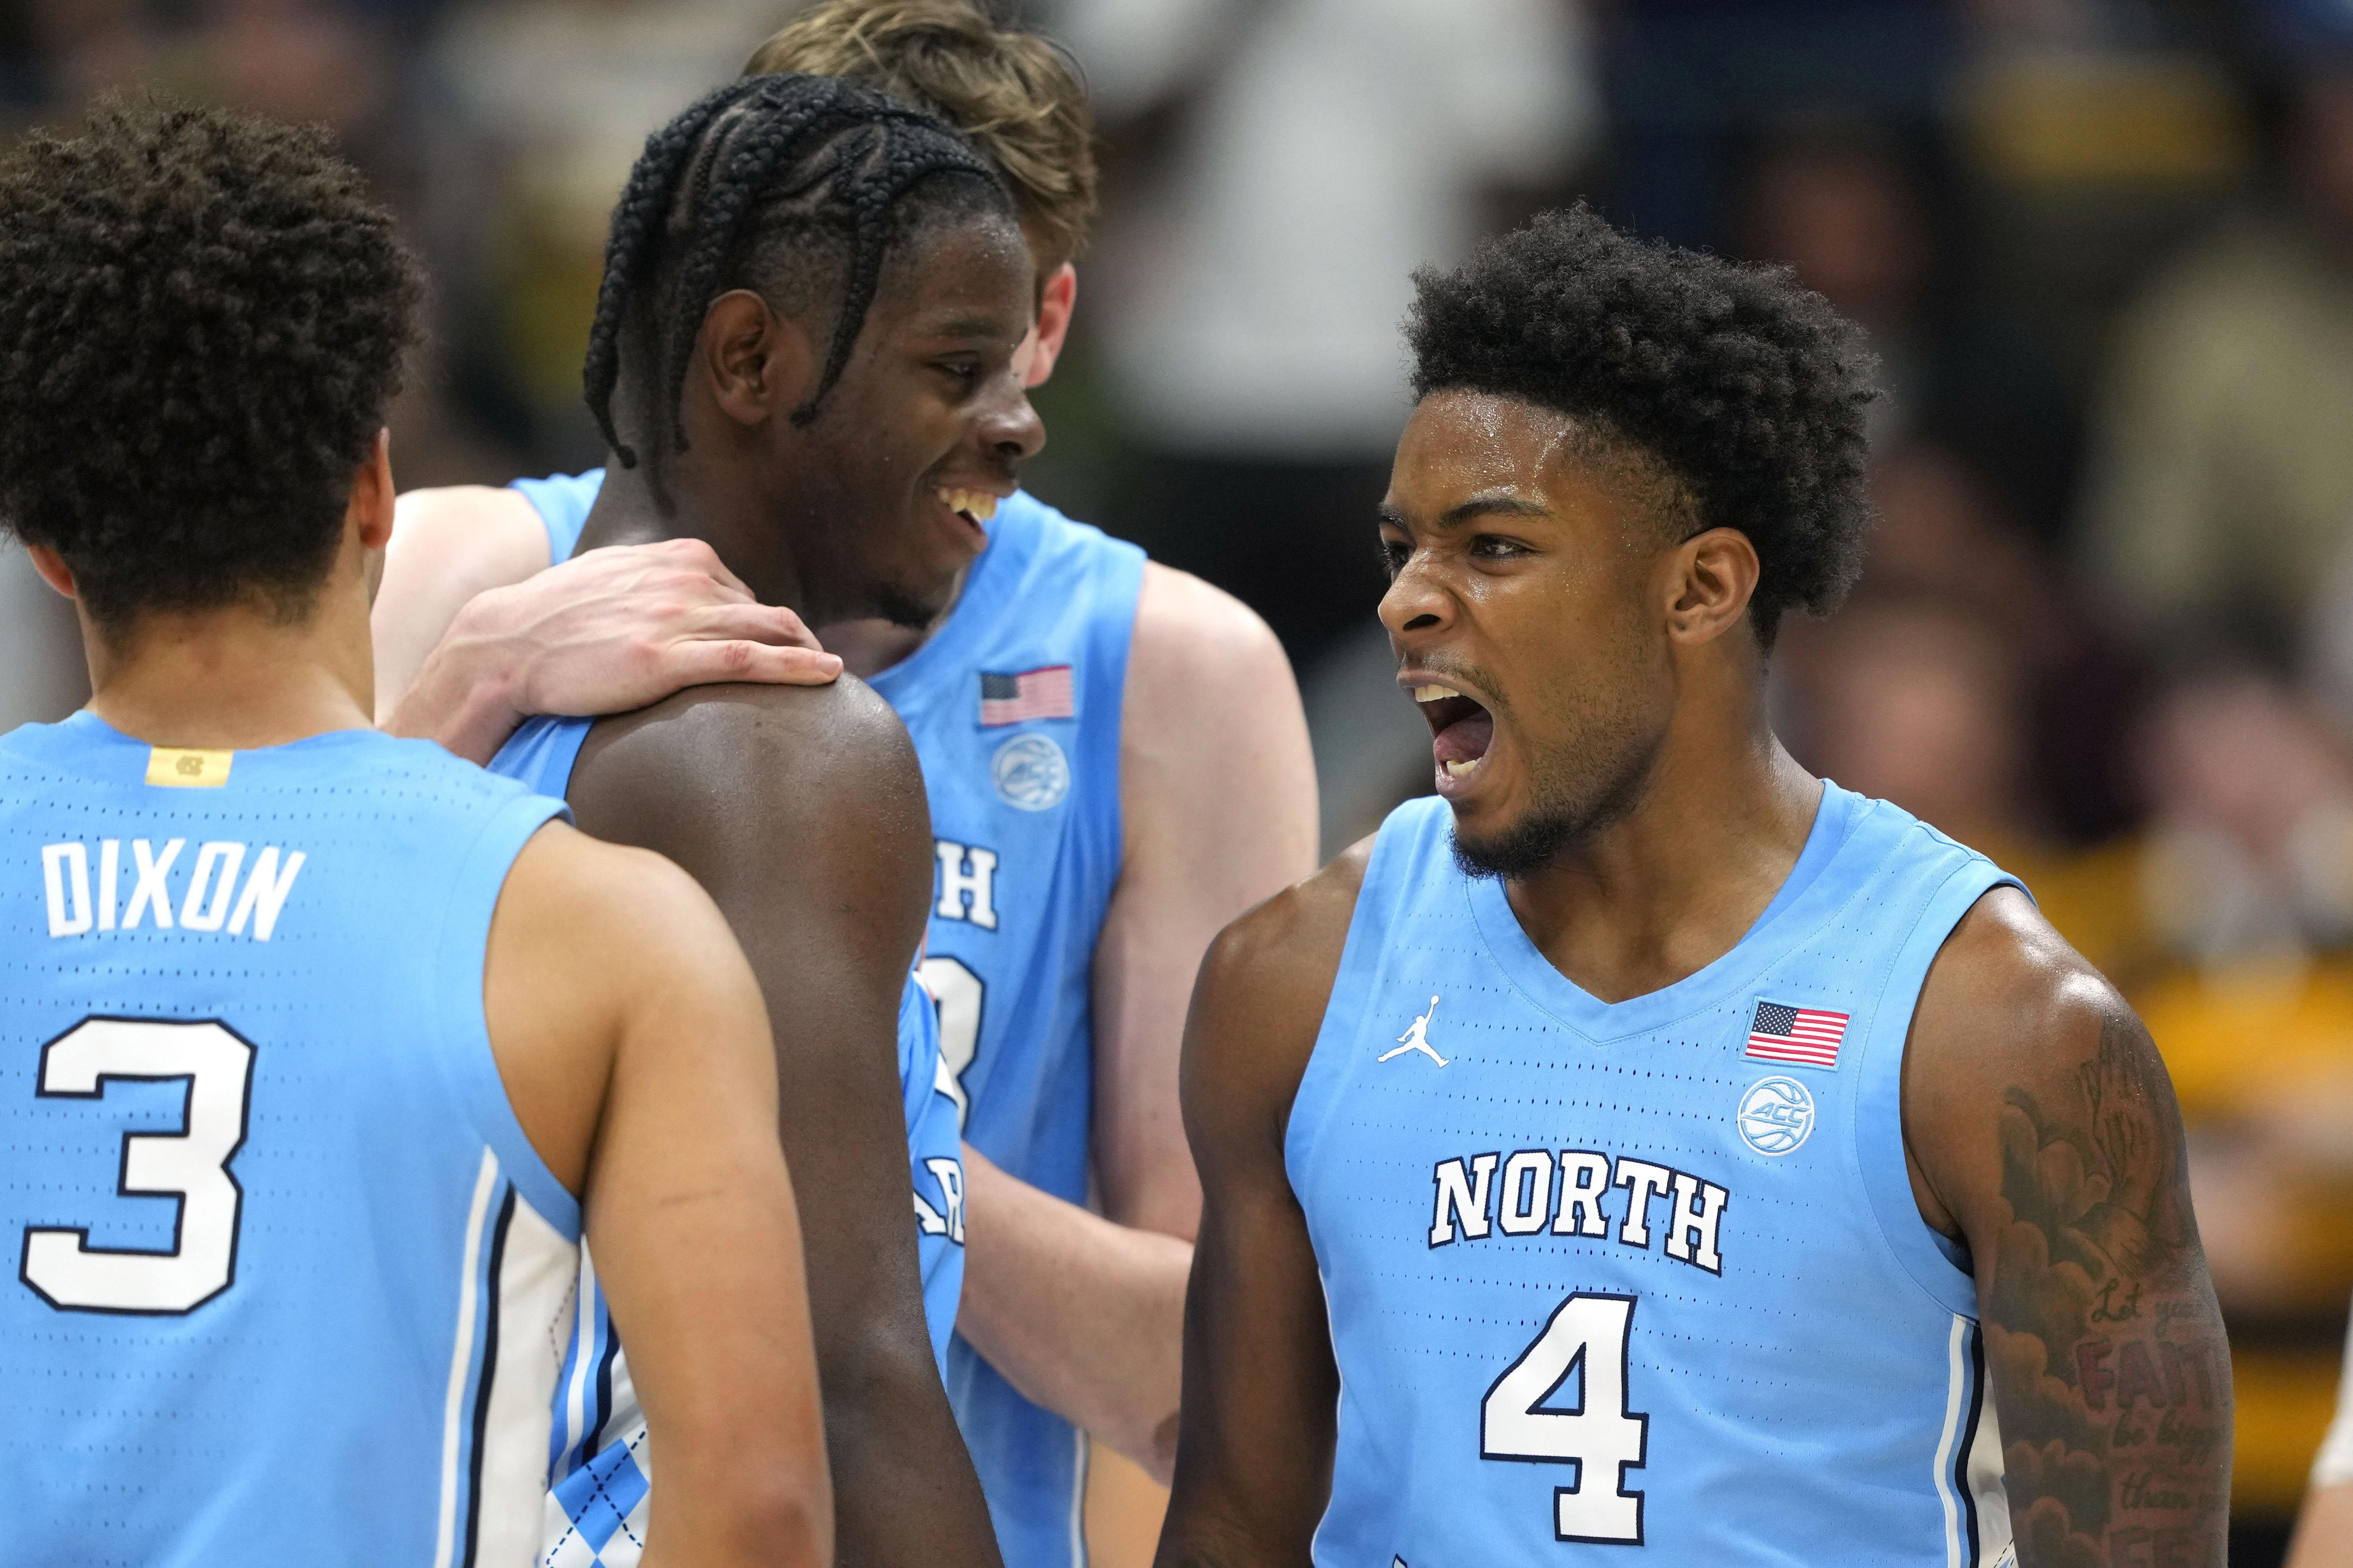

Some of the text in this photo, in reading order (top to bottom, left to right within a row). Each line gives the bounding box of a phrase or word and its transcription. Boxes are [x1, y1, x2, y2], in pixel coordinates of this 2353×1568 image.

[42, 839, 305, 942] DIXON
[19, 1013, 257, 1315] 3
[1751, 1102, 1810, 1124] ACC
[1428, 1148, 1730, 1278] NORTH
[2091, 1278, 2143, 1323] Let
[1479, 1291, 1649, 1546] 4
[2121, 1472, 2191, 1509] than
